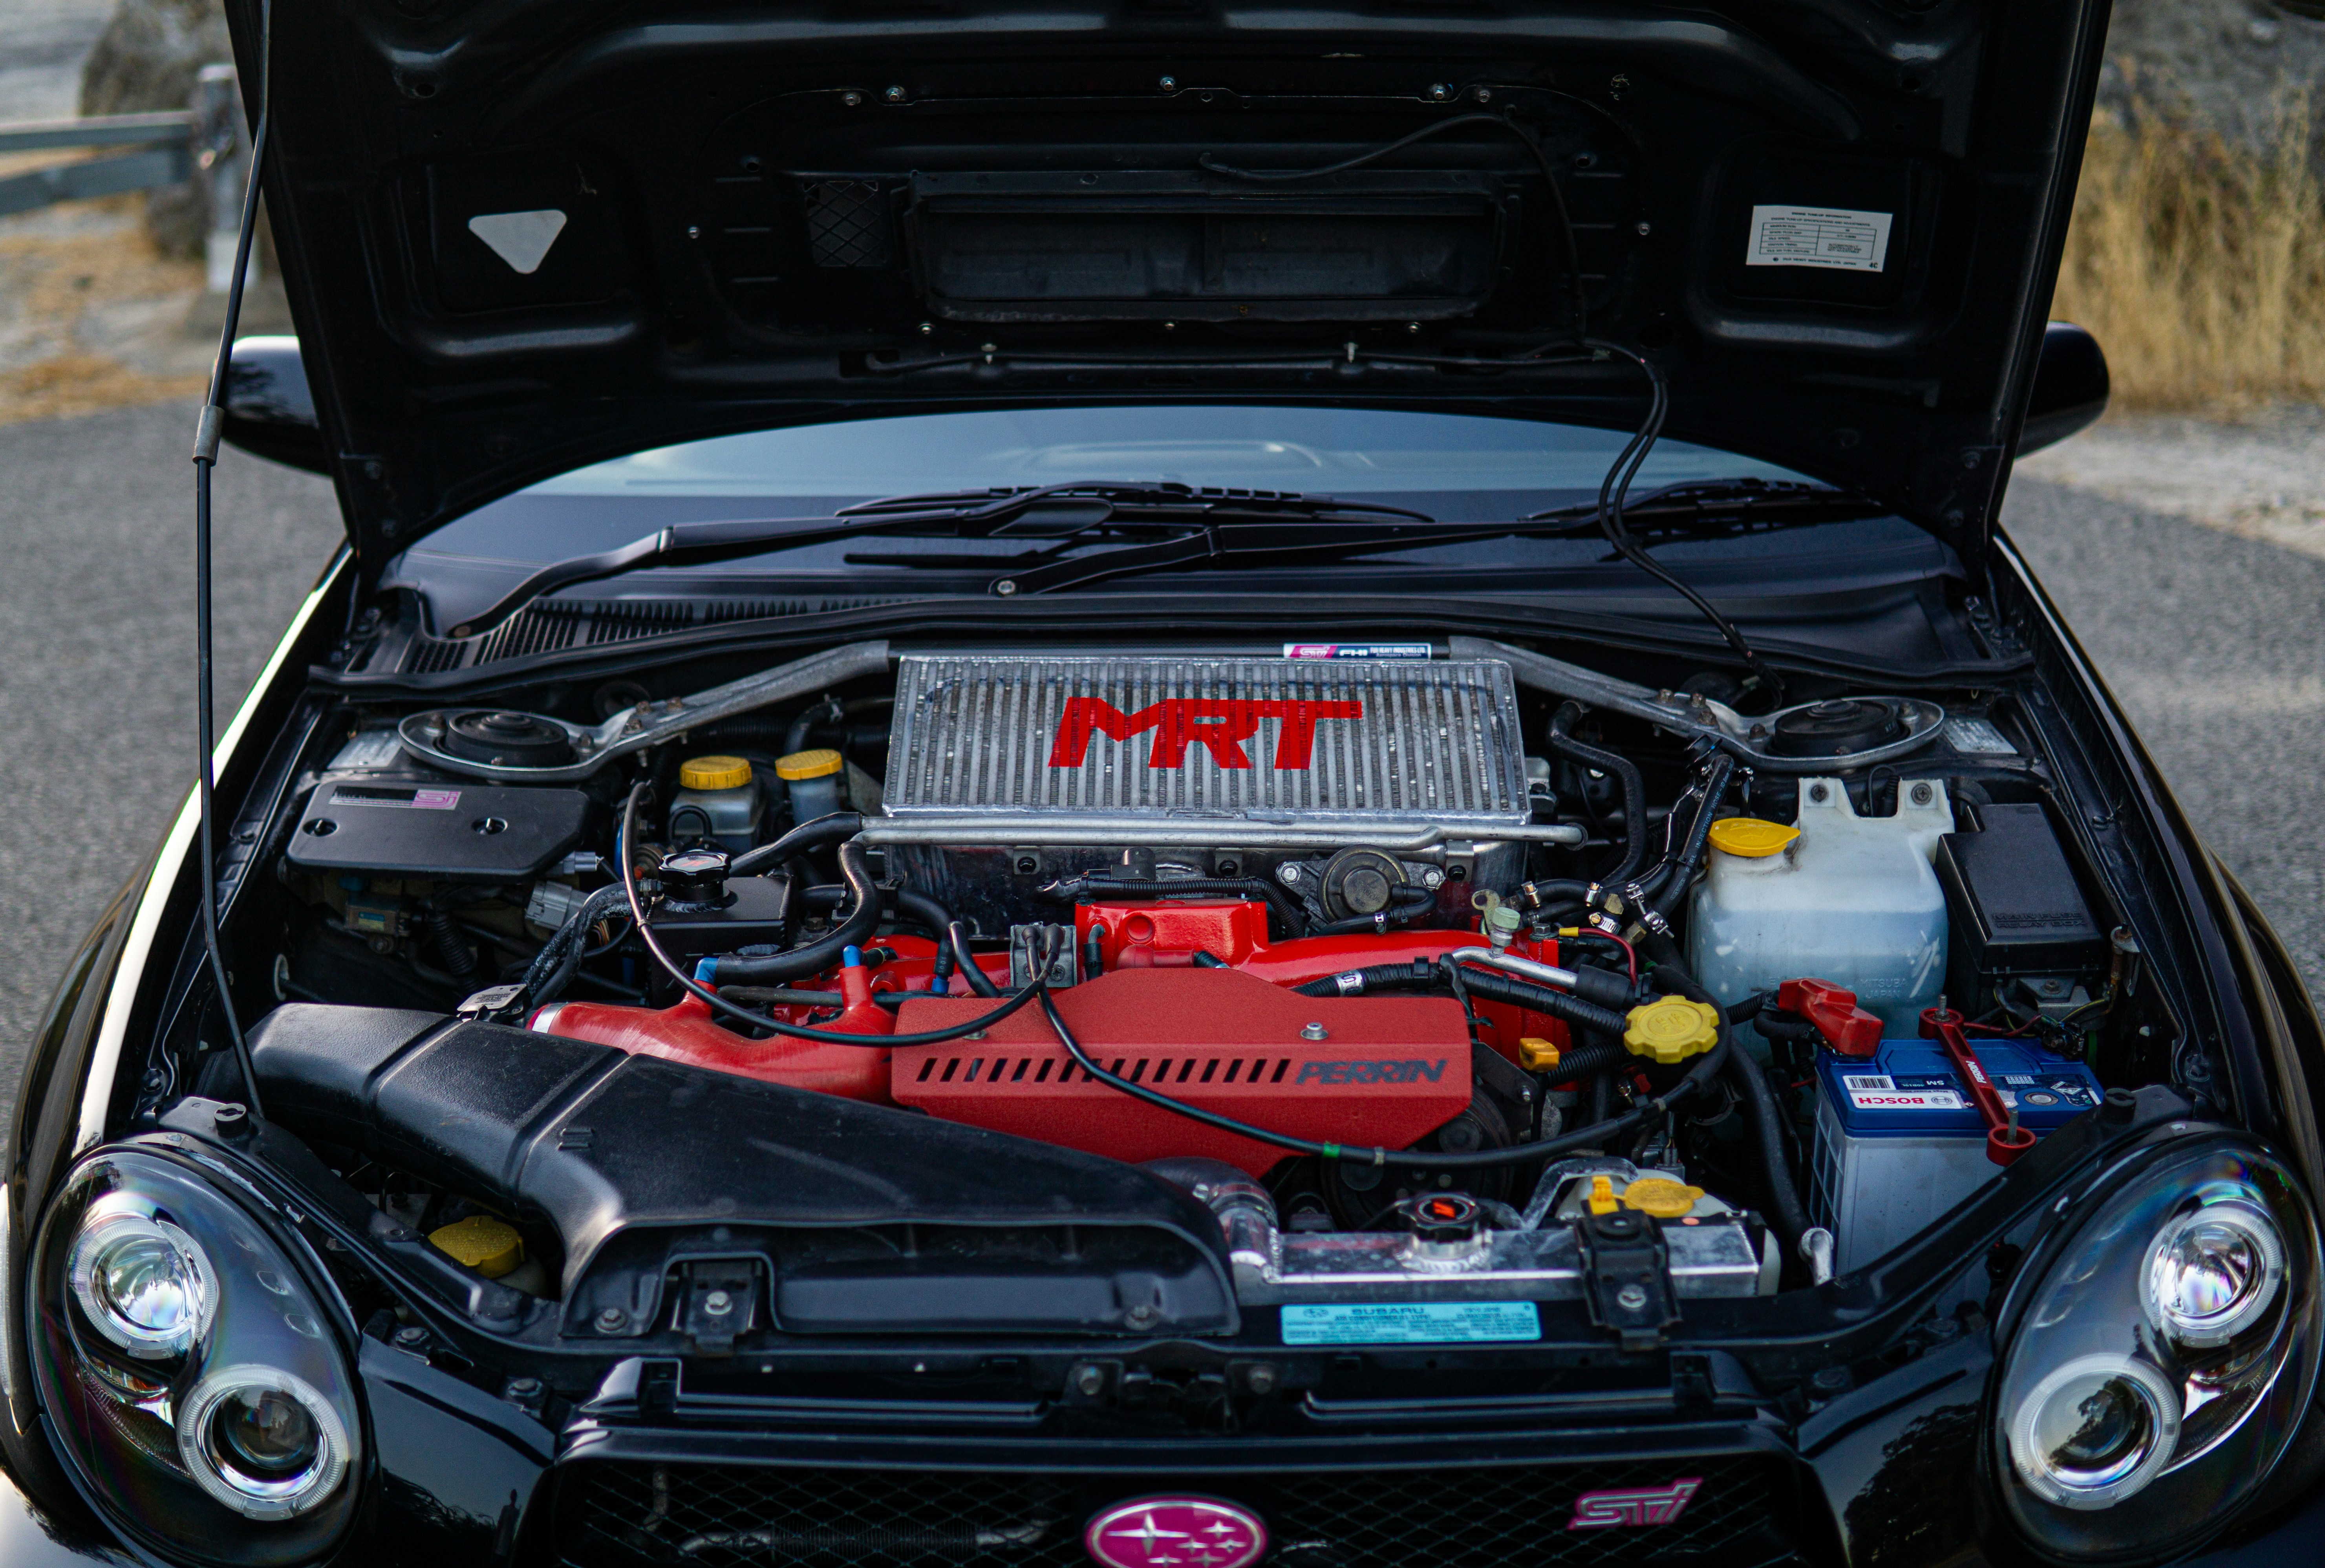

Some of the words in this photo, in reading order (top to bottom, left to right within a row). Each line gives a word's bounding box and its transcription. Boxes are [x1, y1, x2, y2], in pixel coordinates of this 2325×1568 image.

[1048, 696, 1363, 770] MRT
[1695, 811, 1712, 849] INJECTION
[1711, 791, 1721, 810] HOSE
[1992, 912, 2036, 920] MAIN
[1860, 978, 1907, 988] MITSUBA
[1865, 990, 1901, 999] JAPAN
[1295, 1059, 1448, 1085] PERRIN
[1965, 1060, 1987, 1084] PERRIN
[1351, 1306, 1425, 1315] SUBARU
